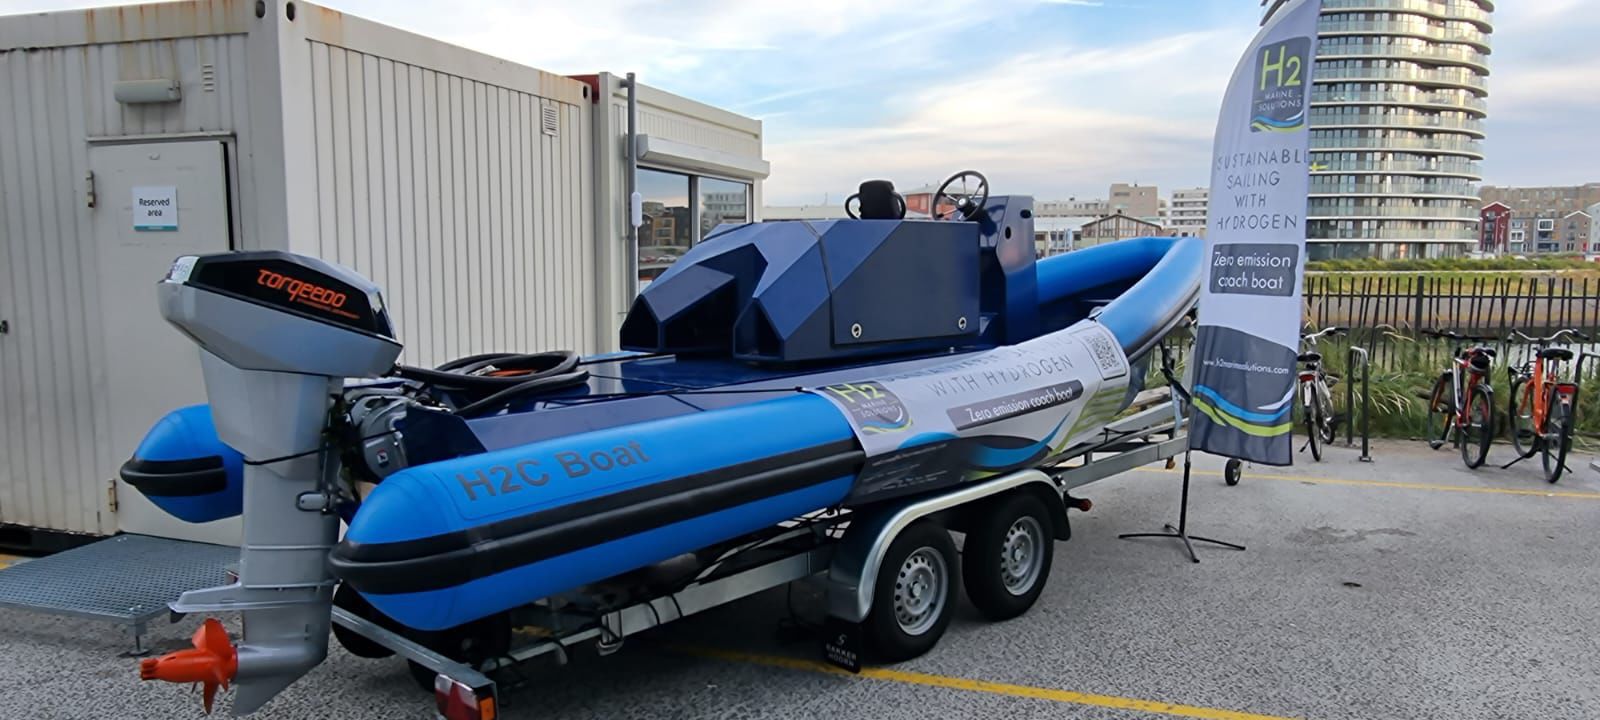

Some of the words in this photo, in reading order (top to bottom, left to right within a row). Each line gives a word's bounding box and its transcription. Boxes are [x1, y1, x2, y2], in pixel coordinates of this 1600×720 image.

[1260, 45, 1301, 91] H2
[1258, 99, 1302, 111] SOLUONS
[1226, 171, 1280, 189] SAILING
[138, 197, 170, 207] Reserved
[1234, 194, 1266, 208] WITH
[147, 209, 163, 217] area
[1216, 214, 1298, 231] HYDROGEN
[1213, 251, 1234, 267] Zero
[1236, 252, 1292, 268] emission
[1218, 272, 1247, 288] coach
[1251, 273, 1284, 290] boat
[1014, 333, 1074, 358] SAING
[926, 375, 979, 398] WITH
[983, 353, 1075, 387] HYDROGEN
[825, 383, 886, 403] H2
[965, 407, 992, 422] Zero
[992, 398, 1031, 417] emission
[1030, 389, 1055, 408] coach
[456, 459, 549, 501] H2C
[554, 440, 650, 478] Boat
